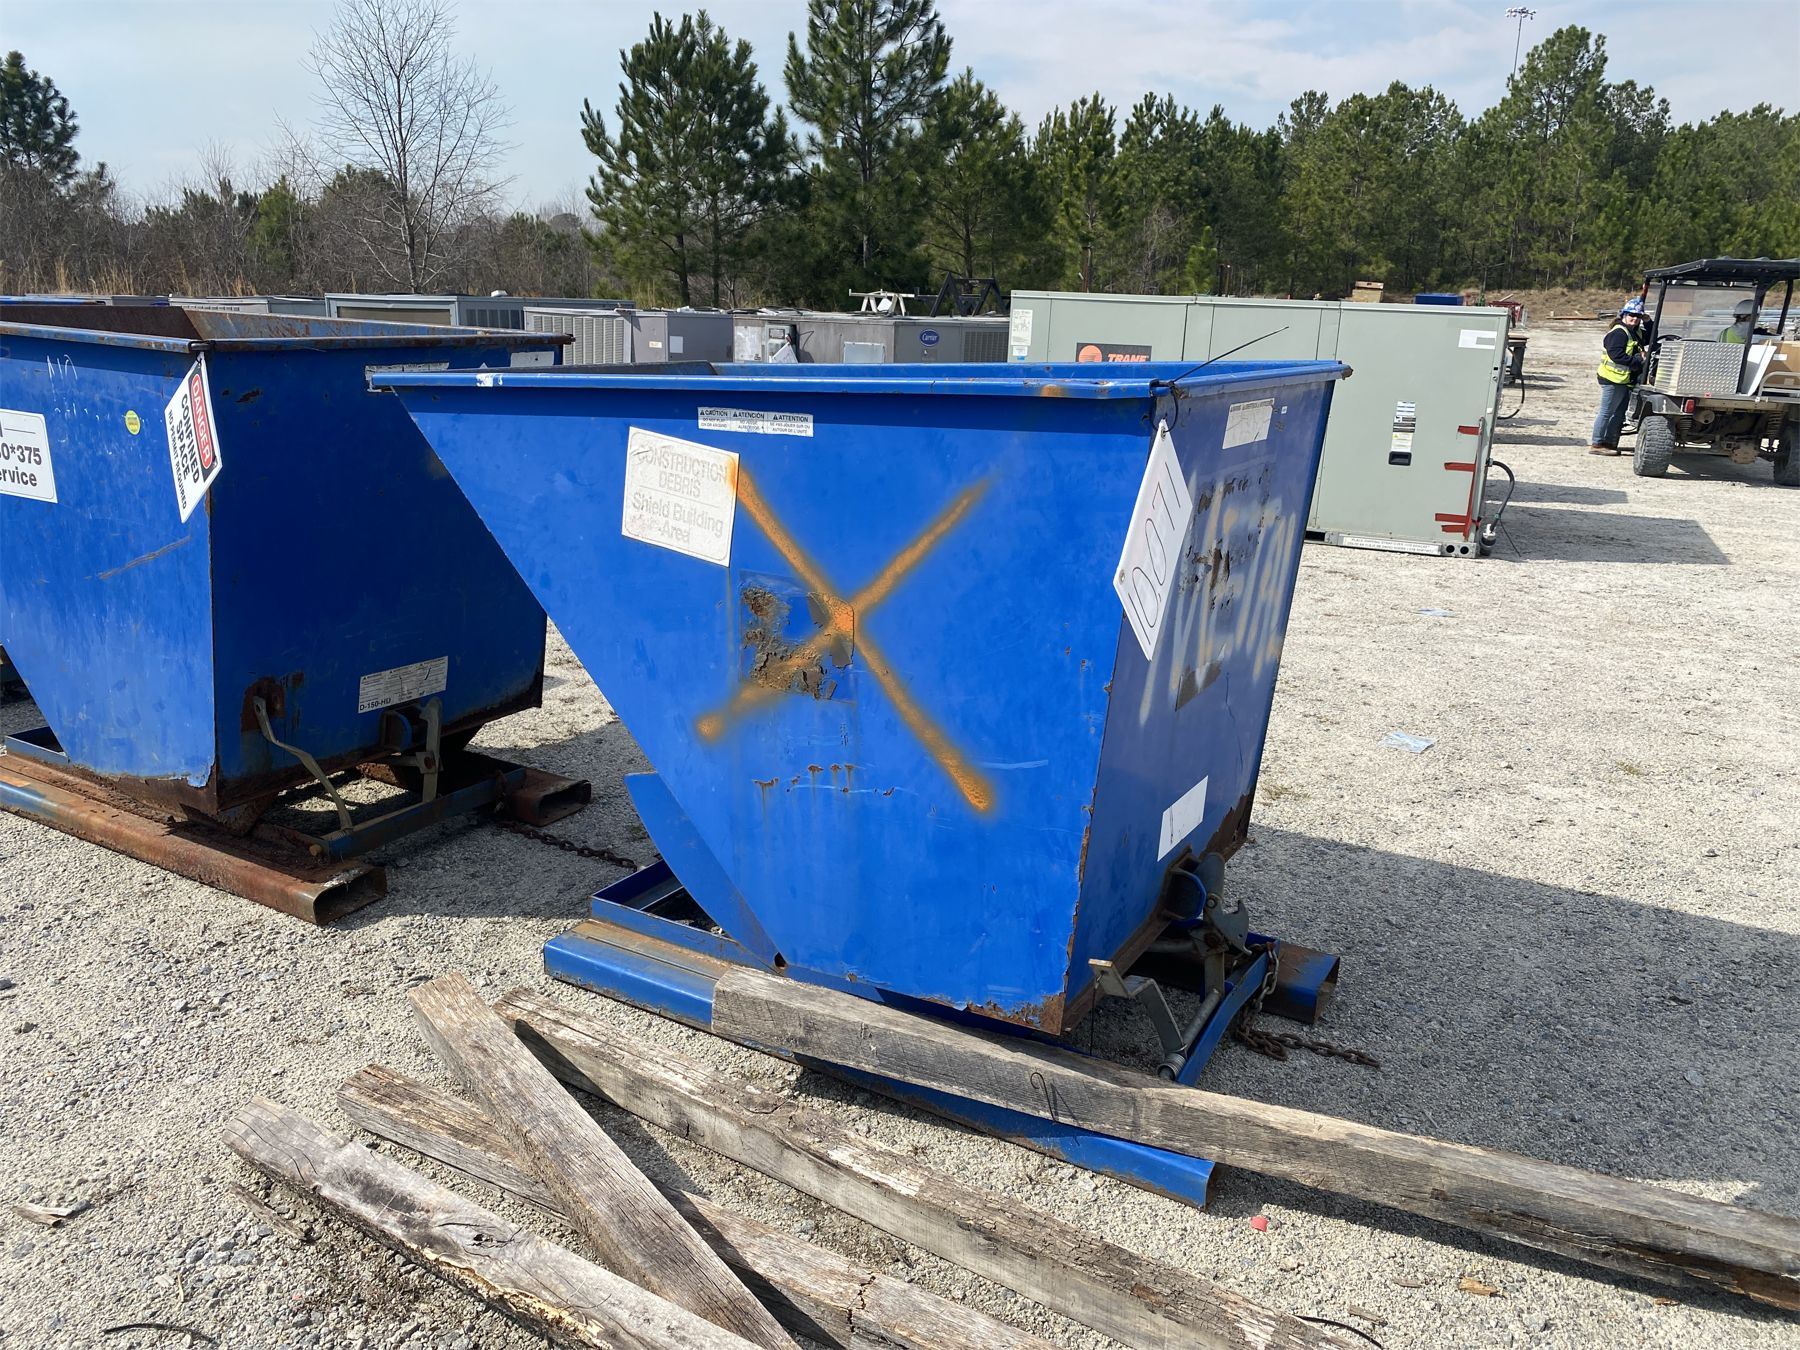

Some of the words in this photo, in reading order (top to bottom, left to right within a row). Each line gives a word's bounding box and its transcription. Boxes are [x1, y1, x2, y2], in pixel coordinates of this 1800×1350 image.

[192, 380, 212, 462] DANGER
[704, 409, 728, 417] CAUTION
[778, 414, 809, 423] ATTENTION
[176, 420, 190, 481] SPACE
[181, 393, 200, 484] CONFINED
[170, 424, 179, 462] PERMIT
[175, 462, 187, 510] REQUIRED
[638, 445, 728, 483] CONSTRUCTION
[659, 471, 701, 498] DEBRIS
[632, 492, 670, 518] Shield
[673, 502, 724, 539] Building
